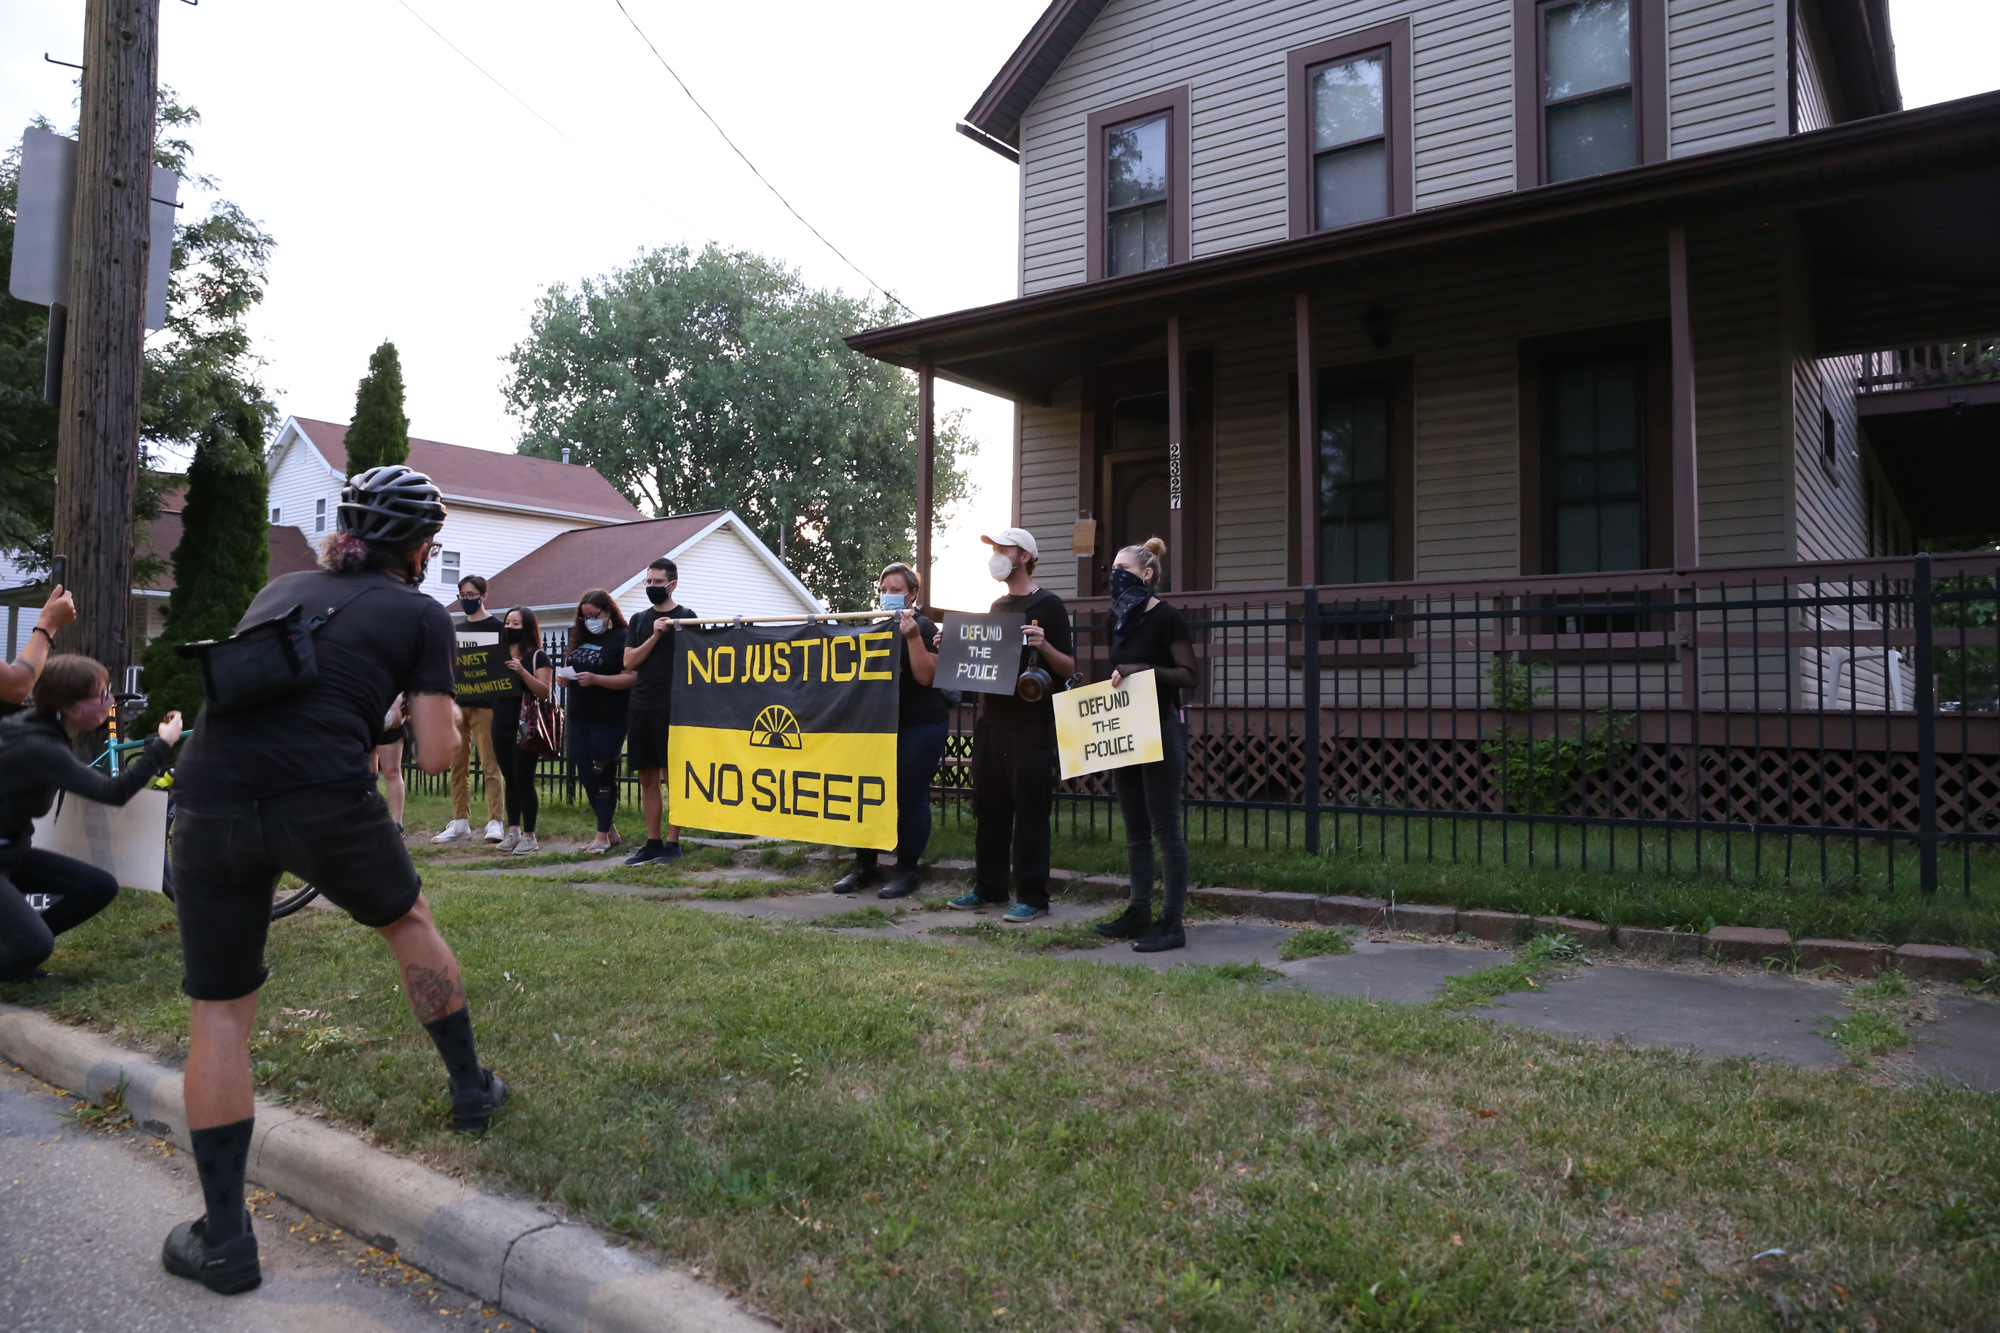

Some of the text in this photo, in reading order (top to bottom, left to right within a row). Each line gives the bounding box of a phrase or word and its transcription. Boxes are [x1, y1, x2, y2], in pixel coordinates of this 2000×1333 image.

[1171, 445, 1180, 508] 2327
[960, 624, 1002, 641] DEFUND
[687, 631, 893, 685] NO JUSTICE
[968, 646, 992, 659] THE
[957, 663, 999, 680] POLICE
[1078, 690, 1130, 718] DEFUND
[1092, 717, 1121, 734] THE
[1084, 734, 1135, 761] POLICE
[685, 760, 886, 823] NO SLEEP
